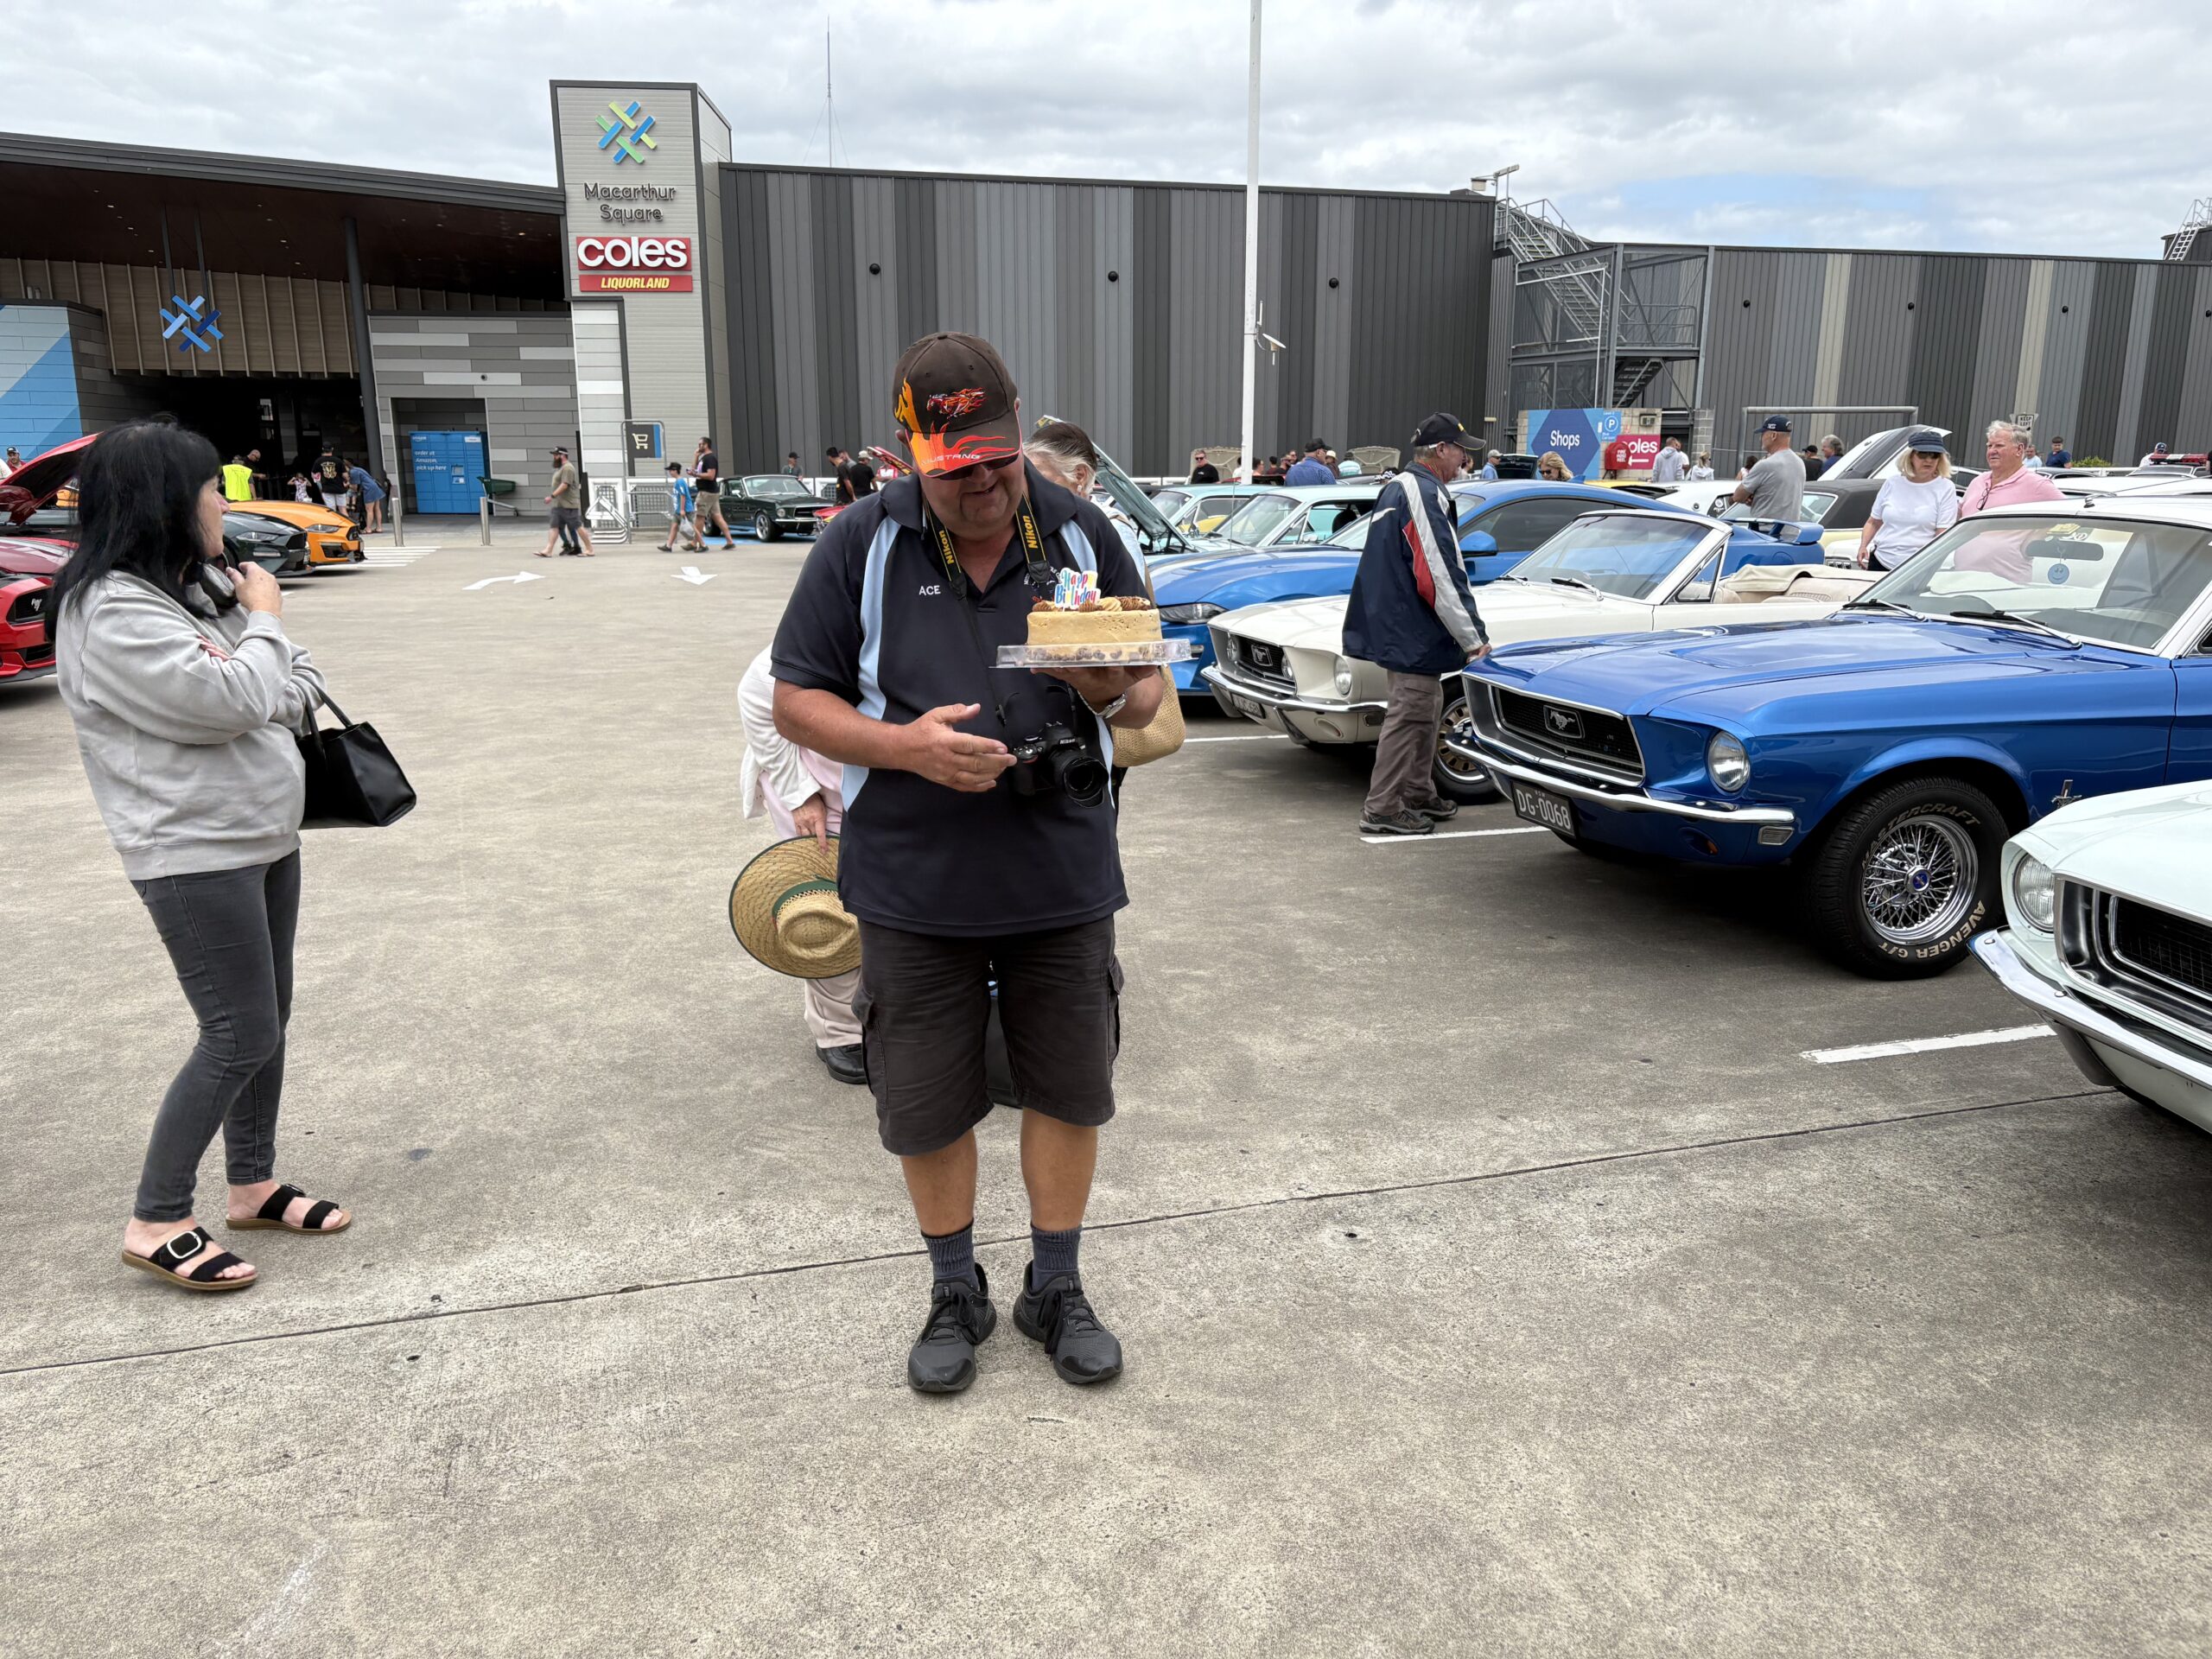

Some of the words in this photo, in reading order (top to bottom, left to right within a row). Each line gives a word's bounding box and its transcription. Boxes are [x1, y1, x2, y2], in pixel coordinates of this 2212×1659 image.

[583, 182, 677, 200] Macarthur
[600, 204, 664, 225] Square
[577, 236, 688, 268] coles
[601, 276, 671, 290] LIQUORLAND
[1608, 419, 1616, 429] P
[1549, 429, 1580, 449] Shops
[1622, 438, 1658, 454] oles
[921, 453, 981, 465] MUSTANG
[1023, 515, 1039, 549] Nikon
[938, 530, 955, 564] Nikon
[918, 585, 941, 596] ACE
[1916, 899, 1986, 959] AVENGER
[1878, 941, 1909, 958] G/T
